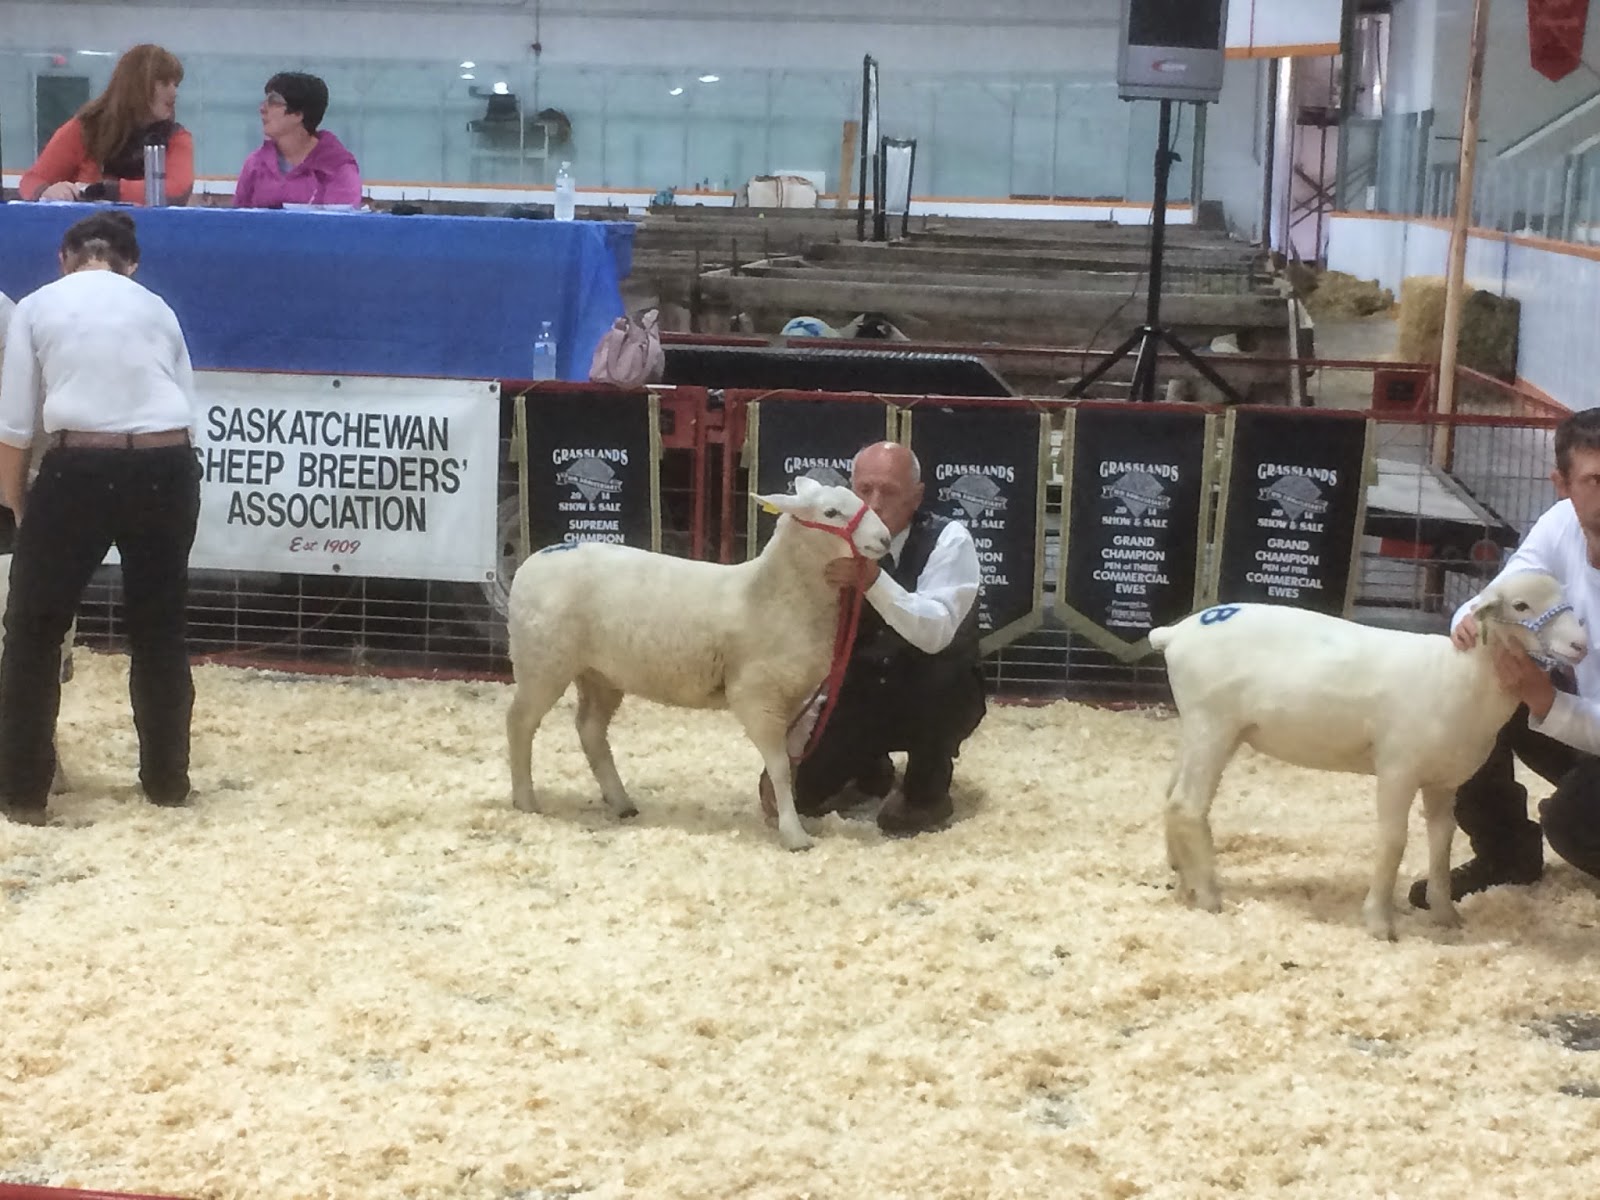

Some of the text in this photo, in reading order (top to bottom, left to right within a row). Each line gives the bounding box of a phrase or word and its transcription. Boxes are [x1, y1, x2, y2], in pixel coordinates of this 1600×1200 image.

[207, 405, 448, 451] SASKATCHEWAN
[552, 448, 629, 466] GRASSLANDS
[784, 457, 853, 473] GRASSLAND
[1099, 460, 1179, 482] GRASSLANDS
[298, 452, 467, 494] BREEDERS'
[936, 464, 1015, 482] GRASSLANDS
[1257, 463, 1338, 487] GRASSLANDS
[227, 490, 426, 533] ASSOCIATION
[598, 503, 622, 511] SALE
[568, 519, 619, 530] SUPREME
[1143, 518, 1168, 528] SALE
[1299, 521, 1324, 533] SALE
[563, 532, 625, 543] CHAMPION
[1113, 535, 1155, 546] GRAND
[1267, 537, 1310, 551] GRAND
[289, 537, 361, 554] Est 1909
[1101, 548, 1165, 561] CHAMPION
[1254, 550, 1319, 566] CHAMPION
[980, 565, 997, 573] WO
[1103, 561, 1121, 570] PEN
[1133, 563, 1158, 572] THREE
[1262, 562, 1279, 572] PEN
[1092, 569, 1170, 585] COMMERCIAL
[1245, 571, 1323, 590] COMMERCIAL
[1115, 582, 1146, 594] EWES
[1267, 585, 1299, 599] EWES
